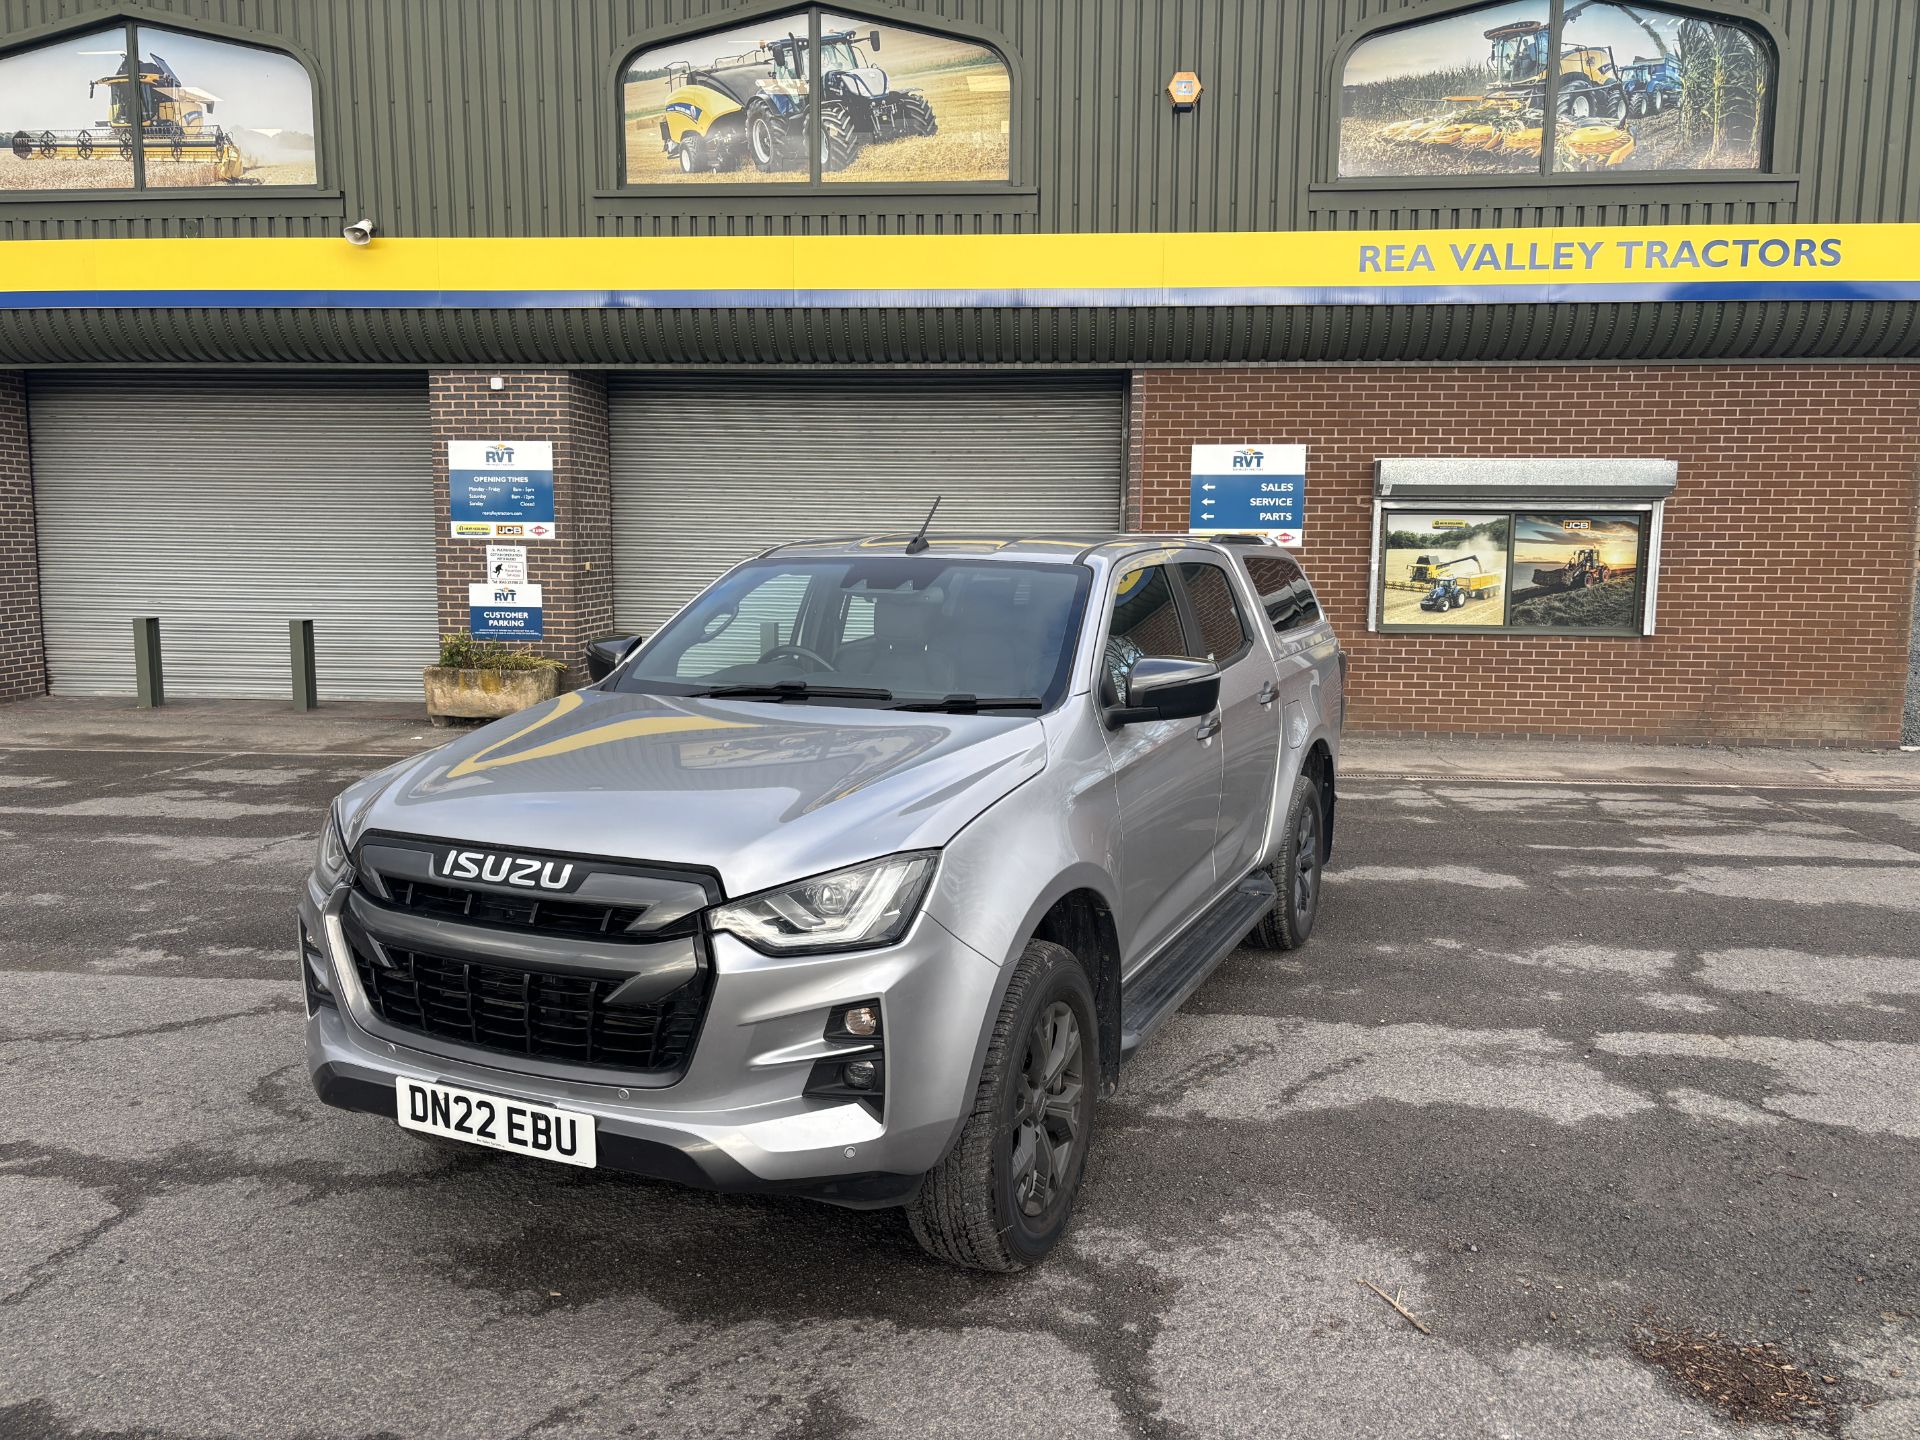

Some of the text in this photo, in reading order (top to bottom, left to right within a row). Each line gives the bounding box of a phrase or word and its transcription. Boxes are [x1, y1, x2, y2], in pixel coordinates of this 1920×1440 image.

[1358, 238, 1842, 272] REA VALLEY TRACTORS
[486, 451, 514, 462] RVT
[1233, 456, 1264, 467] RVT
[1261, 483, 1293, 491] SALES
[1250, 498, 1292, 506] SERVICE
[495, 593, 516, 601] RVT
[442, 850, 573, 889] ISUZU
[409, 1084, 577, 1156] DN22 EBU
